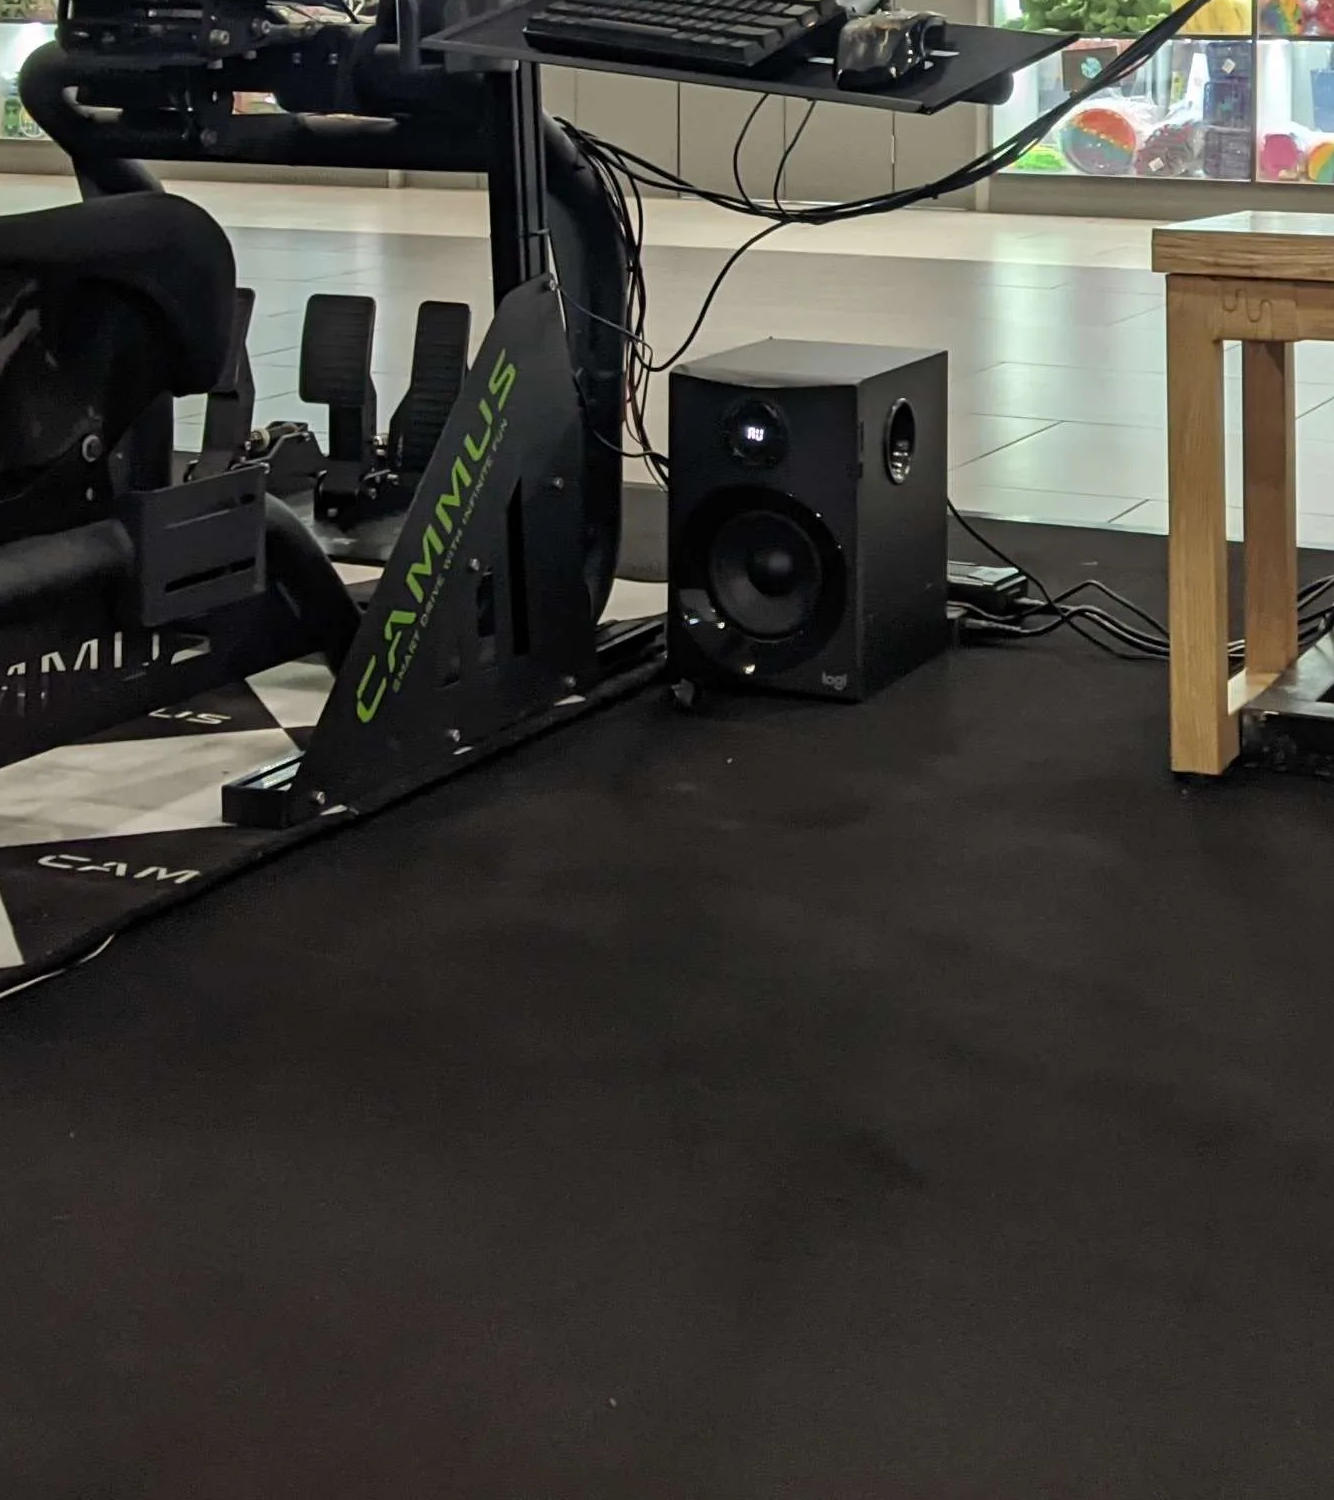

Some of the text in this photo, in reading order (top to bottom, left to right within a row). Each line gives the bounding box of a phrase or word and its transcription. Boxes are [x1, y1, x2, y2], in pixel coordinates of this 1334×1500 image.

[356, 348, 517, 724] CAMMUS
[444, 528, 463, 570] WITH
[492, 417, 508, 452] FUN
[821, 671, 848, 691] logi
[36, 853, 203, 886] CAM
